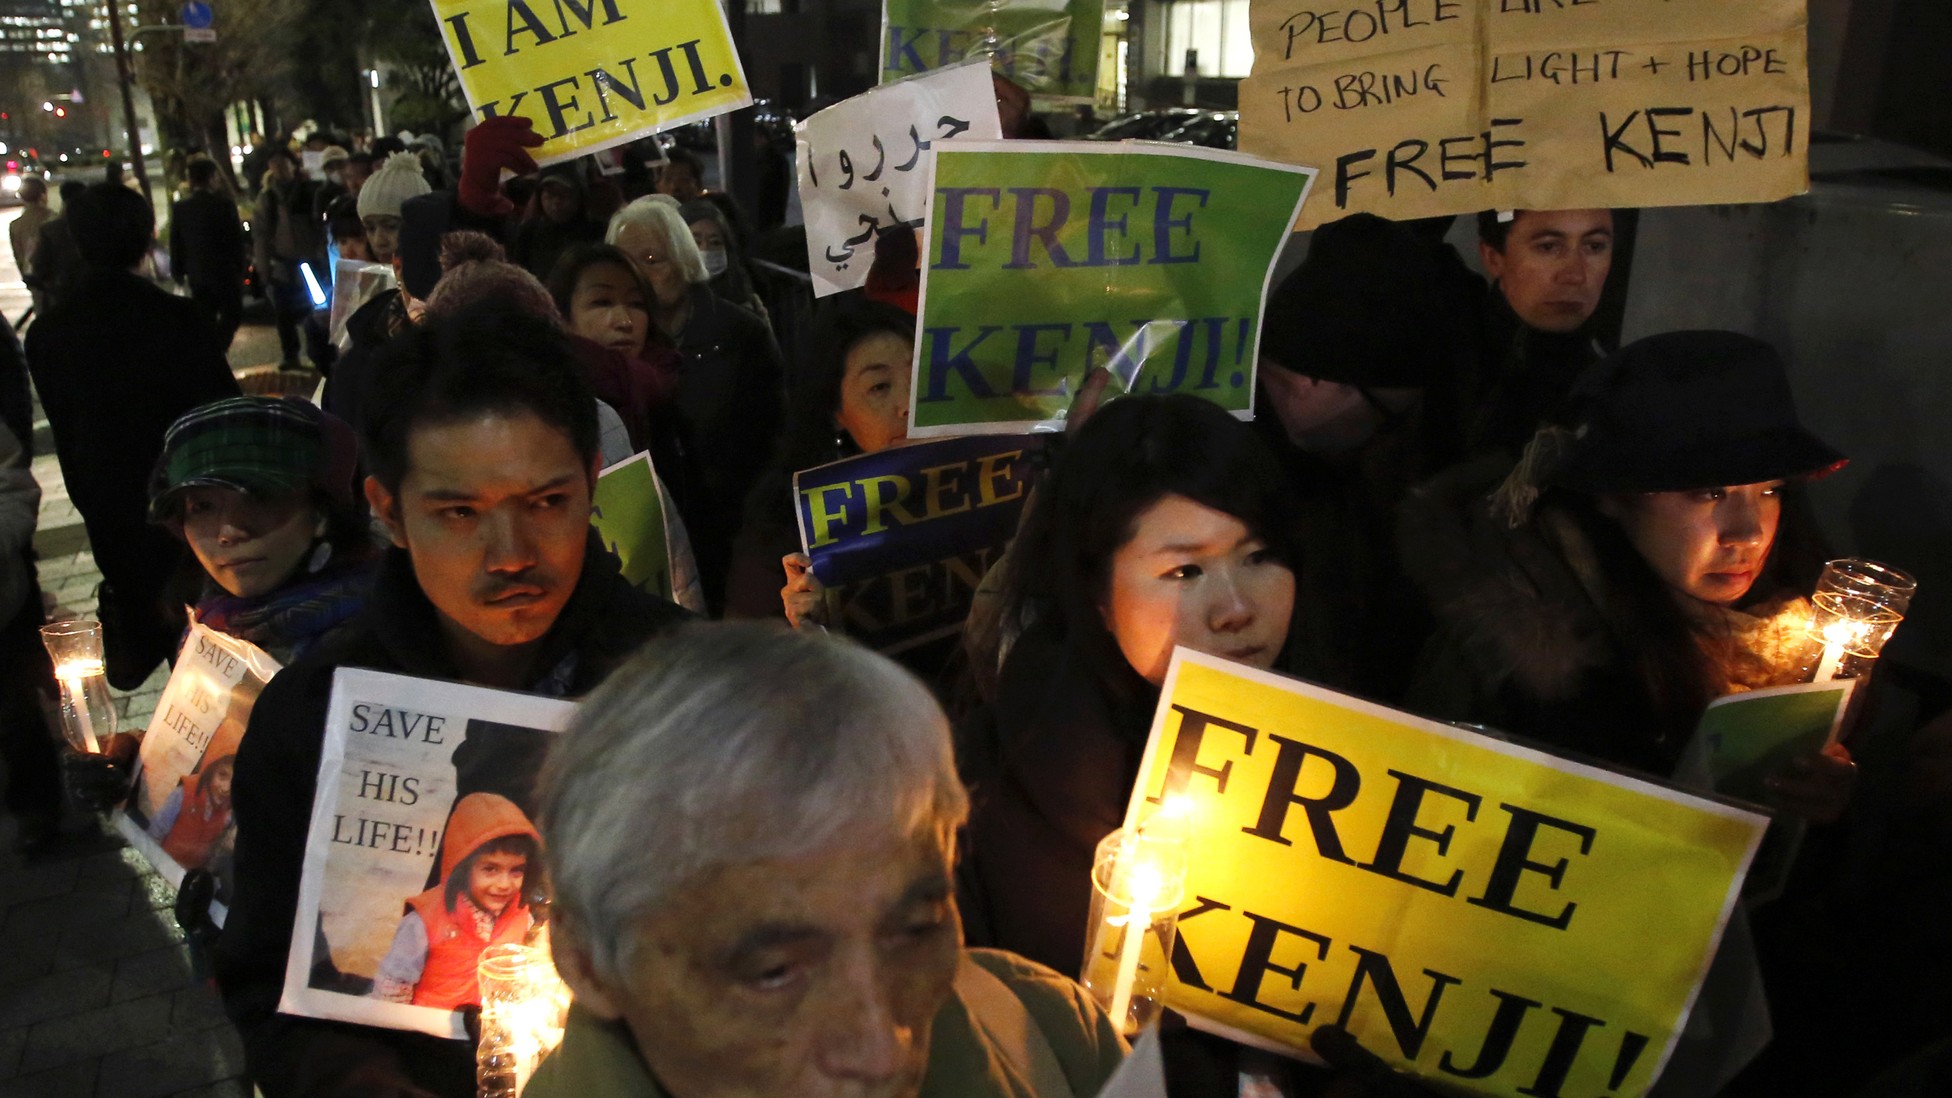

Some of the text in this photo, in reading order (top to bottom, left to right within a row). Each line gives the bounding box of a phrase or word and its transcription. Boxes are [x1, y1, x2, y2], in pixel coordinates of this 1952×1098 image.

[444, 0, 628, 70] I AM
[1279, 0, 1462, 60] PEOPLE
[1277, 46, 1787, 121] TO BRING LIGHT + HOPE
[1335, 106, 1794, 209] FREE KENJI
[930, 187, 1210, 270] FREE
[916, 316, 1251, 402] KENJI!
[800, 449, 1023, 549] FREE
[195, 635, 239, 678] SAVE
[163, 704, 209, 753] LIFE!!
[350, 704, 446, 745] SAVE
[357, 770, 420, 805] HIS
[1146, 703, 1597, 931] FREE
[331, 814, 438, 858] LIFE!!
[1102, 896, 1650, 1098] KENJI!
